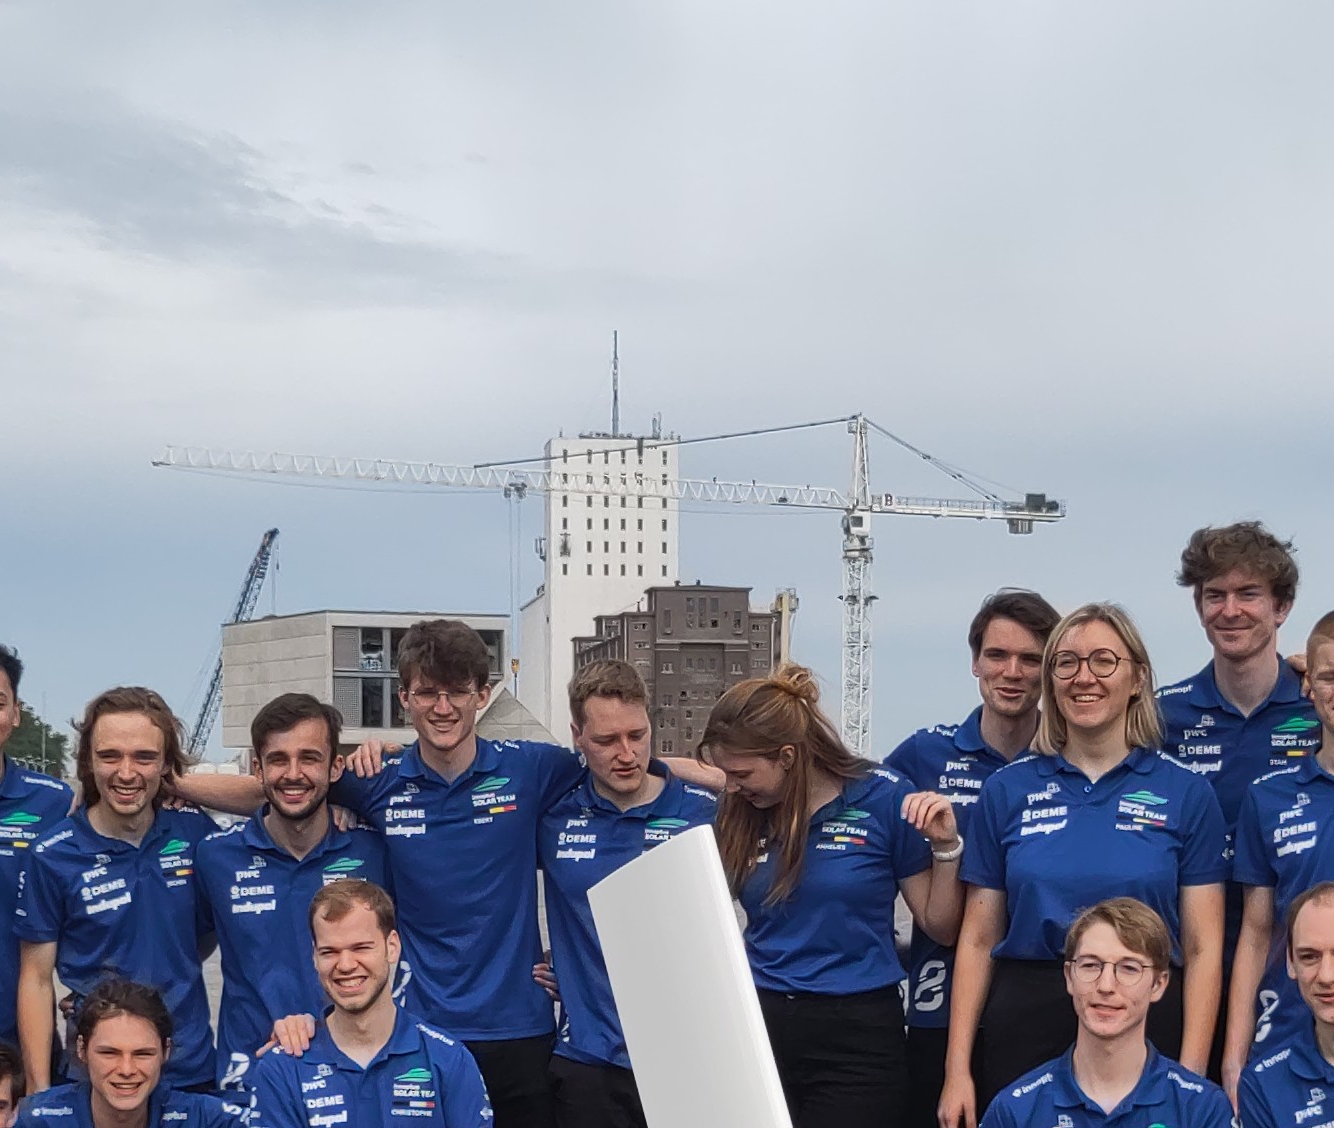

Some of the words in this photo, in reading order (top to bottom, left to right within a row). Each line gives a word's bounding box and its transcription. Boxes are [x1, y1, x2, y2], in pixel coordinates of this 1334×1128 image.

[1183, 729, 1208, 740] pwc
[1187, 745, 1222, 755] DEME
[945, 761, 970, 772] pwc
[948, 778, 982, 789] DEME
[472, 797, 496, 807] SOLAR
[495, 794, 516, 804] TEAM
[1027, 792, 1053, 805] pwc
[393, 809, 425, 819] DEME
[1031, 806, 1067, 820] DEME
[1143, 811, 1167, 821] TEAM
[385, 823, 426, 838] indupol
[845, 827, 868, 837] TEAM
[1020, 819, 1067, 836] indupol
[1282, 821, 1317, 840] DEME
[565, 834, 597, 844] DEME
[82, 867, 107, 882] pwc
[92, 879, 127, 896] DEME
[240, 885, 275, 897] DEME
[306, 1094, 345, 1108] DEME
[1295, 1105, 1323, 1124] pwc
